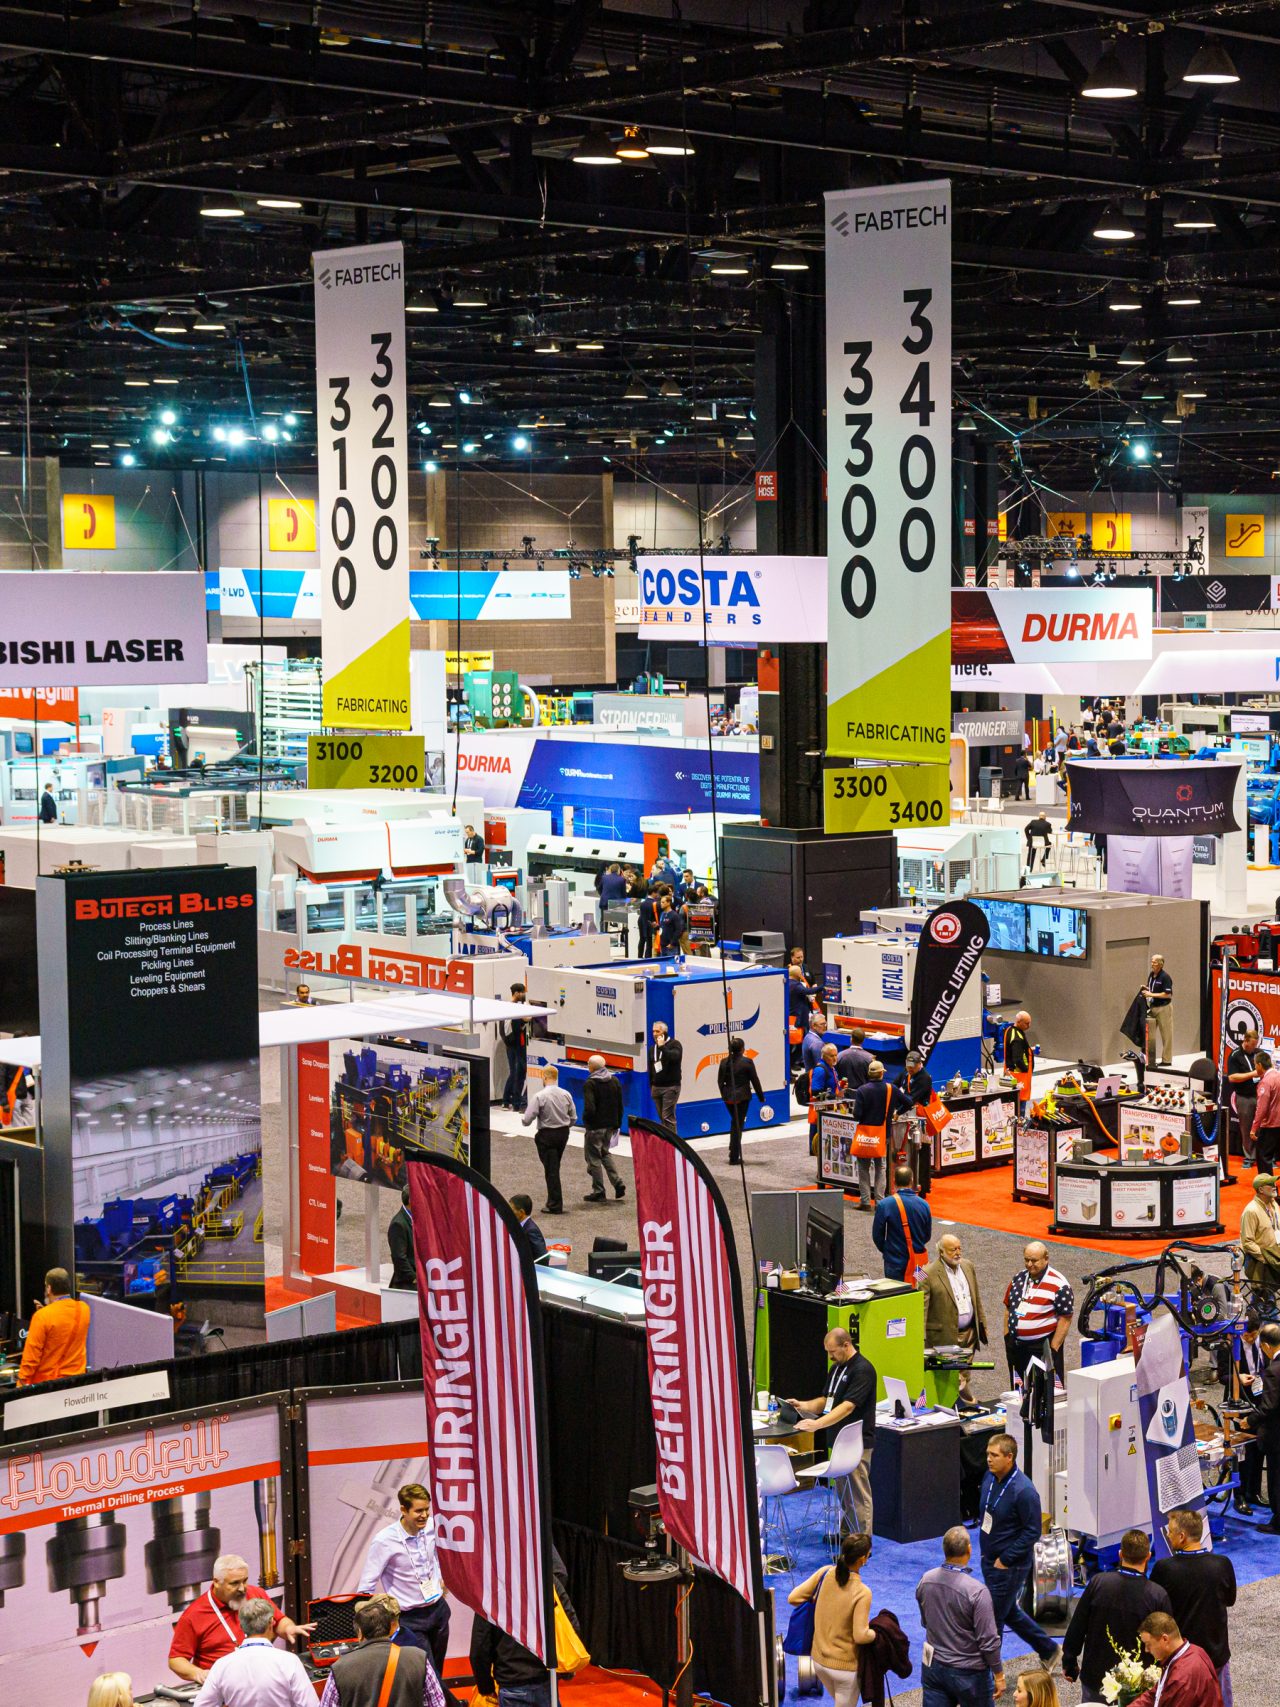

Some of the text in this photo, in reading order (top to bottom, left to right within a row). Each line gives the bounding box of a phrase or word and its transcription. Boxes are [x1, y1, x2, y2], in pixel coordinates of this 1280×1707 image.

[854, 205, 947, 233] FABTECH
[334, 262, 402, 287] FABTECH
[899, 288, 936, 573] 3400
[370, 332, 398, 571] 3200
[758, 475, 774, 485] FIRE
[841, 341, 877, 619] 3300
[328, 376, 357, 611] 3100
[758, 486, 775, 497] HOSE
[228, 588, 244, 598] LVD
[643, 568, 760, 607] COSTA
[643, 610, 762, 625] SANDERS
[1021, 612, 1139, 643] DURMA
[85, 639, 184, 663] LASER
[337, 697, 408, 714] FABRICATING
[103, 712, 113, 726] P2
[958, 719, 1007, 738] STRONGER
[846, 721, 946, 744] FABRICATING
[316, 742, 363, 761] 3100
[458, 753, 512, 774] DURMA
[369, 765, 419, 784] 3200
[833, 774, 887, 799] 3300
[889, 799, 943, 824] 3400
[1132, 802, 1224, 818] QUANTUM
[179, 893, 254, 914] BLISS
[139, 920, 194, 932] Process Lines
[125, 931, 209, 946] Slitting/Blanking Lines
[97, 941, 236, 961] Coil Processing Terminal Equipment
[882, 954, 902, 963] COSTA
[141, 958, 194, 971] Pickling Lines
[130, 969, 206, 985] Leveling Equipment
[882, 966, 903, 1001] METAL
[130, 982, 206, 998] Choppers & Shears
[597, 987, 616, 997] COSTA
[920, 934, 985, 1062] AGNETIC LIFTING
[596, 1002, 616, 1018] METAL
[822, 1118, 855, 1131] MAGNETS
[1121, 1108, 1186, 1125] TRANSPORTER MAGNETS
[856, 1134, 880, 1145] Mazak
[643, 1219, 687, 1501] BEHRINGER
[64, 1391, 108, 1407] Flowdrill Inc
[425, 1255, 475, 1553] BEHRINGER
[2, 1416, 230, 1510] Flowdrill
[62, 1483, 185, 1518] Thermal Drilling Process
